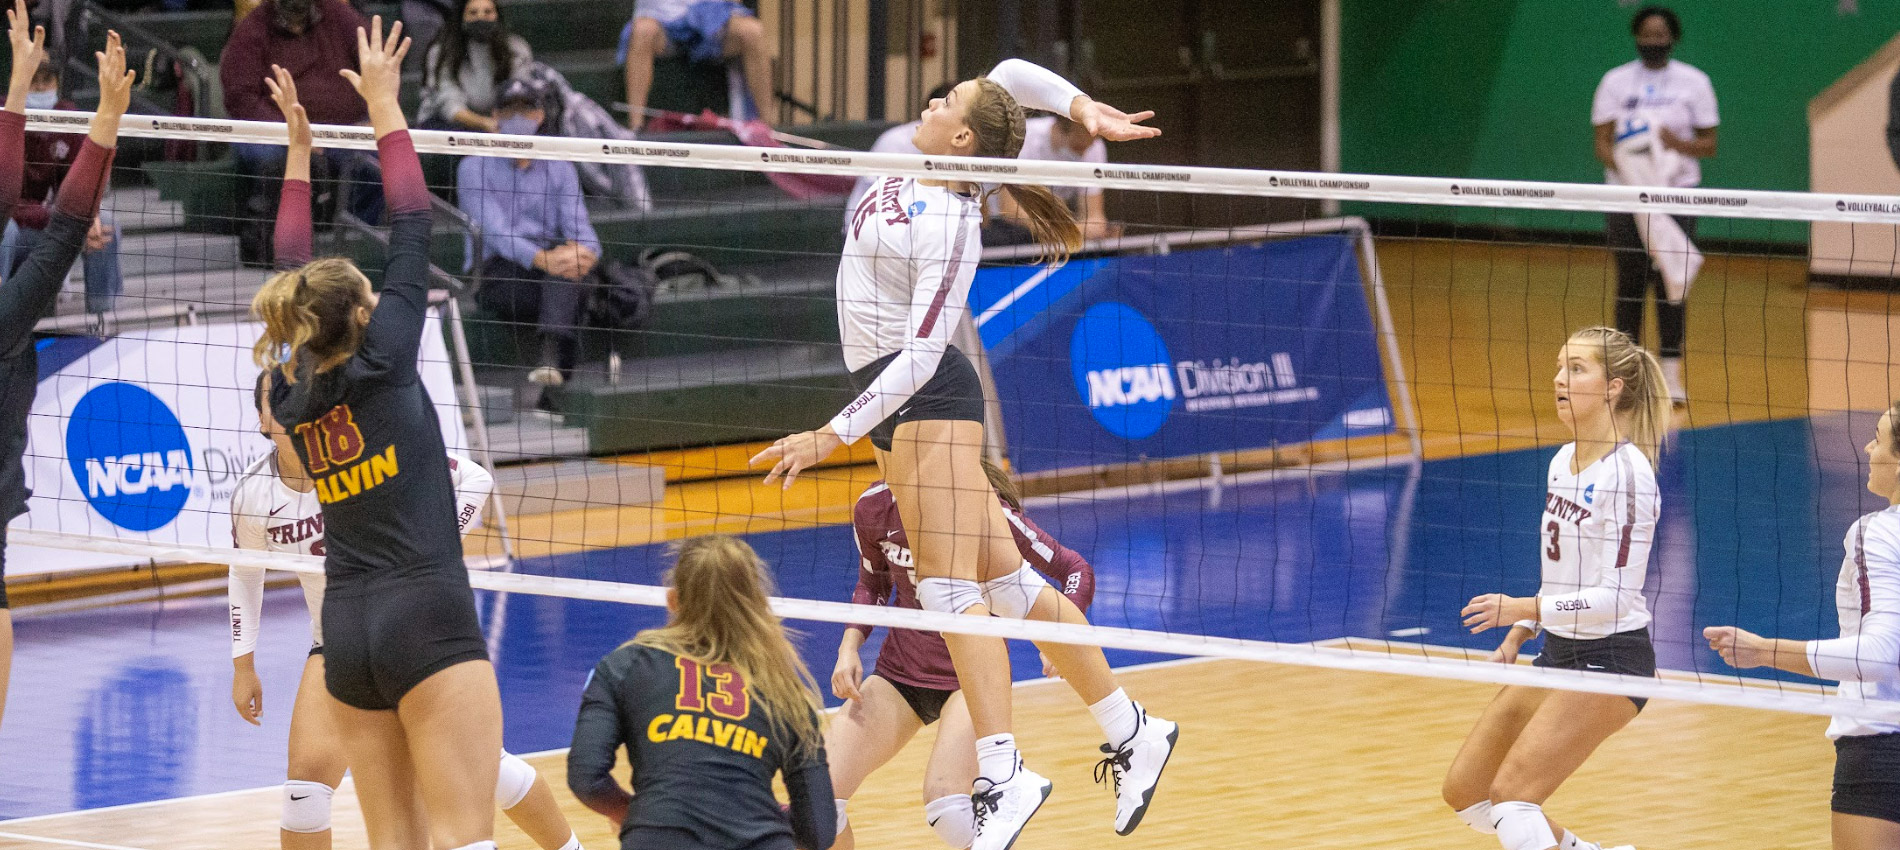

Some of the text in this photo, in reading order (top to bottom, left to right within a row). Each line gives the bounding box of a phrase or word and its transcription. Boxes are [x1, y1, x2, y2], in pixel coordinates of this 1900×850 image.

[26, 114, 89, 124] LEYBALL CHAMPIONSHIP
[160, 122, 233, 132] VOLLEYBALL CHAMPIONSHIP
[457, 138, 533, 149] VOLLEYBALL CHAMPIONSHIP
[611, 146, 690, 157] VOLLEYBALL CHAMPIONSHIP
[770, 154, 852, 165] VOLLEYBALL CHAMPIONSHIP
[934, 162, 1018, 173] VOLLEYBALL CHAMPIONSHIP
[1103, 170, 1191, 181] VOLLEYBALL CHAMPIONSHIP
[1279, 178, 1370, 190] VOLLEYBALL CHAMPIONSHIP
[1461, 186, 1555, 198] VOLLEYBALL CHAMPIONSHIP
[1650, 194, 1748, 206] VOLLEYBALL CHAMPIONSHIP
[851, 189, 877, 241] 15
[1847, 202, 1889, 213] VOLLEYBALL
[1087, 363, 1176, 408] NCAA
[1177, 356, 1274, 398] Division
[842, 391, 877, 418] TIGERS
[295, 404, 365, 473] 18
[85, 449, 192, 498] NCAA
[316, 444, 399, 504] ALVIN
[459, 503, 477, 531] IGERS
[267, 512, 324, 544] TRIN
[1546, 520, 1561, 562] 3
[1555, 598, 1591, 611] TIGERS
[231, 604, 241, 643] TRINITY
[675, 655, 749, 720] 13
[647, 714, 768, 759] CALVIN
